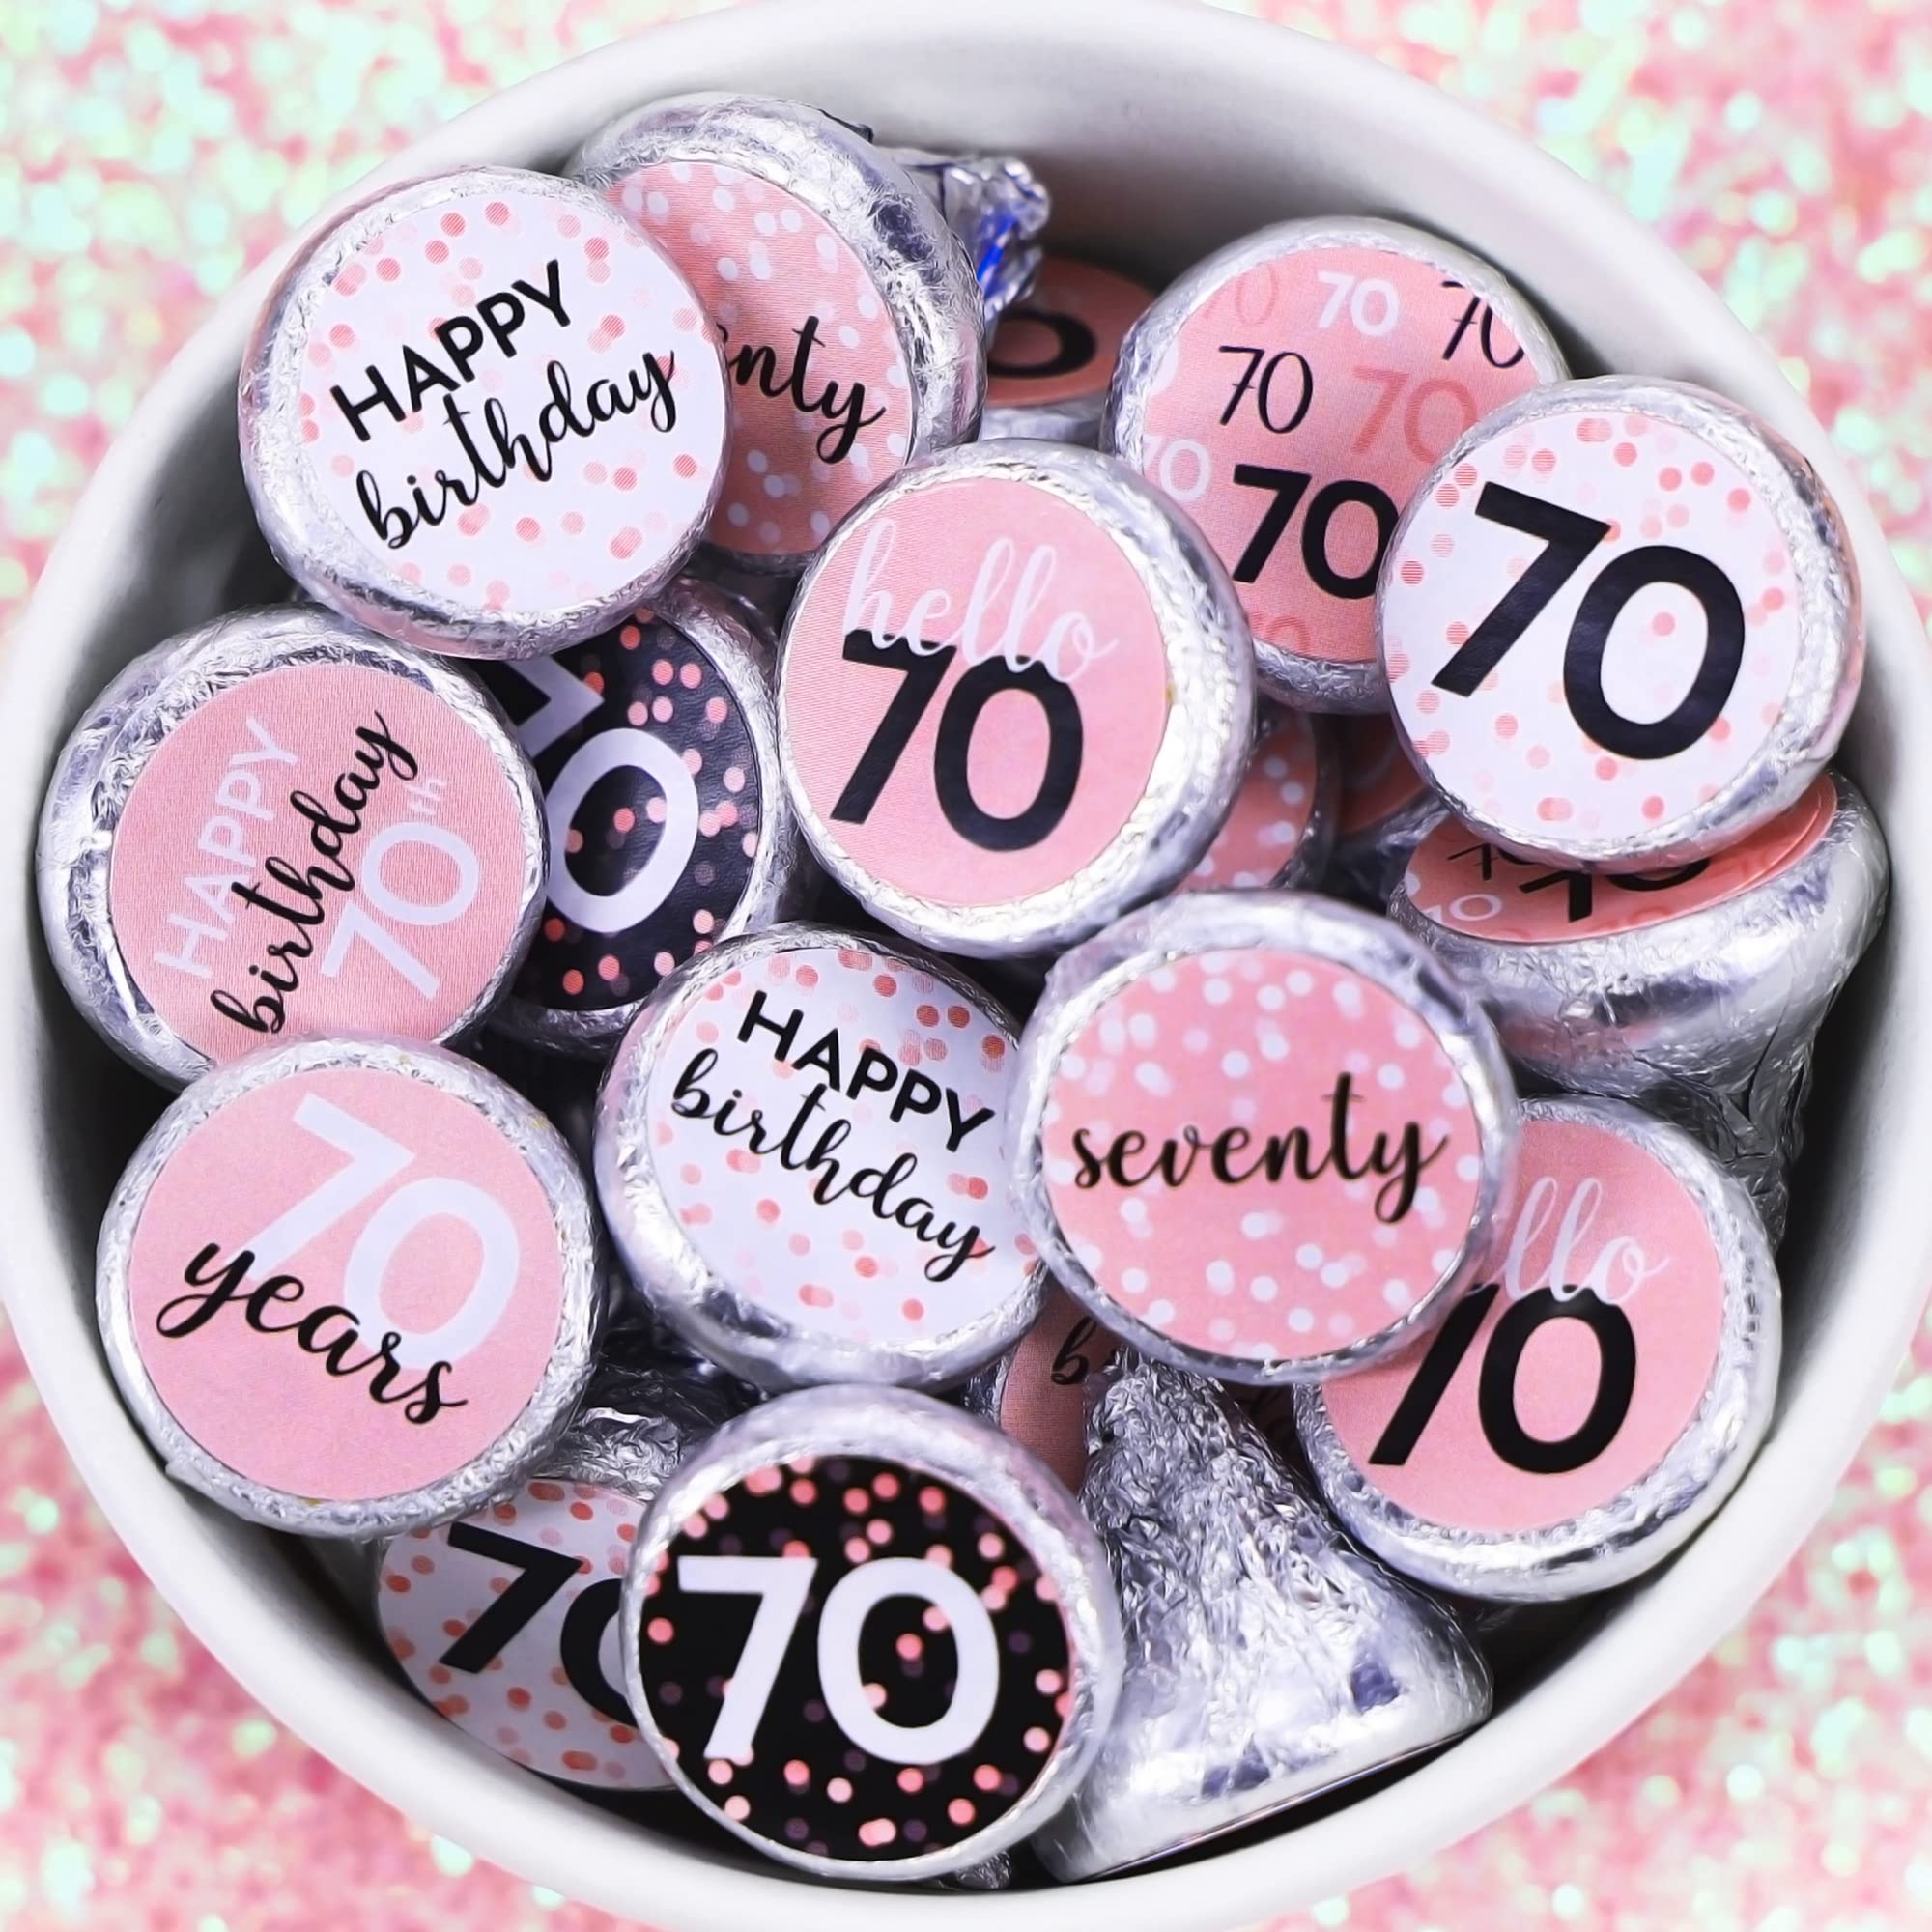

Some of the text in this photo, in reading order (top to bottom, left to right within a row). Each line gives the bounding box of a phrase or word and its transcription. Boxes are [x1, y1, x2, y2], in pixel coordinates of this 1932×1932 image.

[330, 259, 571, 442] HAPPY
[715, 315, 887, 464] nty
[1218, 345, 1315, 435] 70
[1317, 270, 1400, 336] 70
[355, 350, 676, 550] birthday
[1352, 364, 1478, 465] 70
[843, 518, 1120, 684] hello
[1233, 463, 1400, 601] 70
[1431, 480, 1747, 761] 70
[830, 628, 1084, 853] 70
[153, 714, 299, 980] HAPPY
[209, 709, 419, 1035] birthday
[737, 989, 996, 1153] HAPPY
[1072, 1071, 1451, 1225] seventy
[240, 1092, 522, 1371] 70
[670, 1047, 997, 1283] birthday
[1464, 1175, 1671, 1305] llo
[156, 1242, 469, 1426] years
[677, 1555, 1000, 1765] 70
